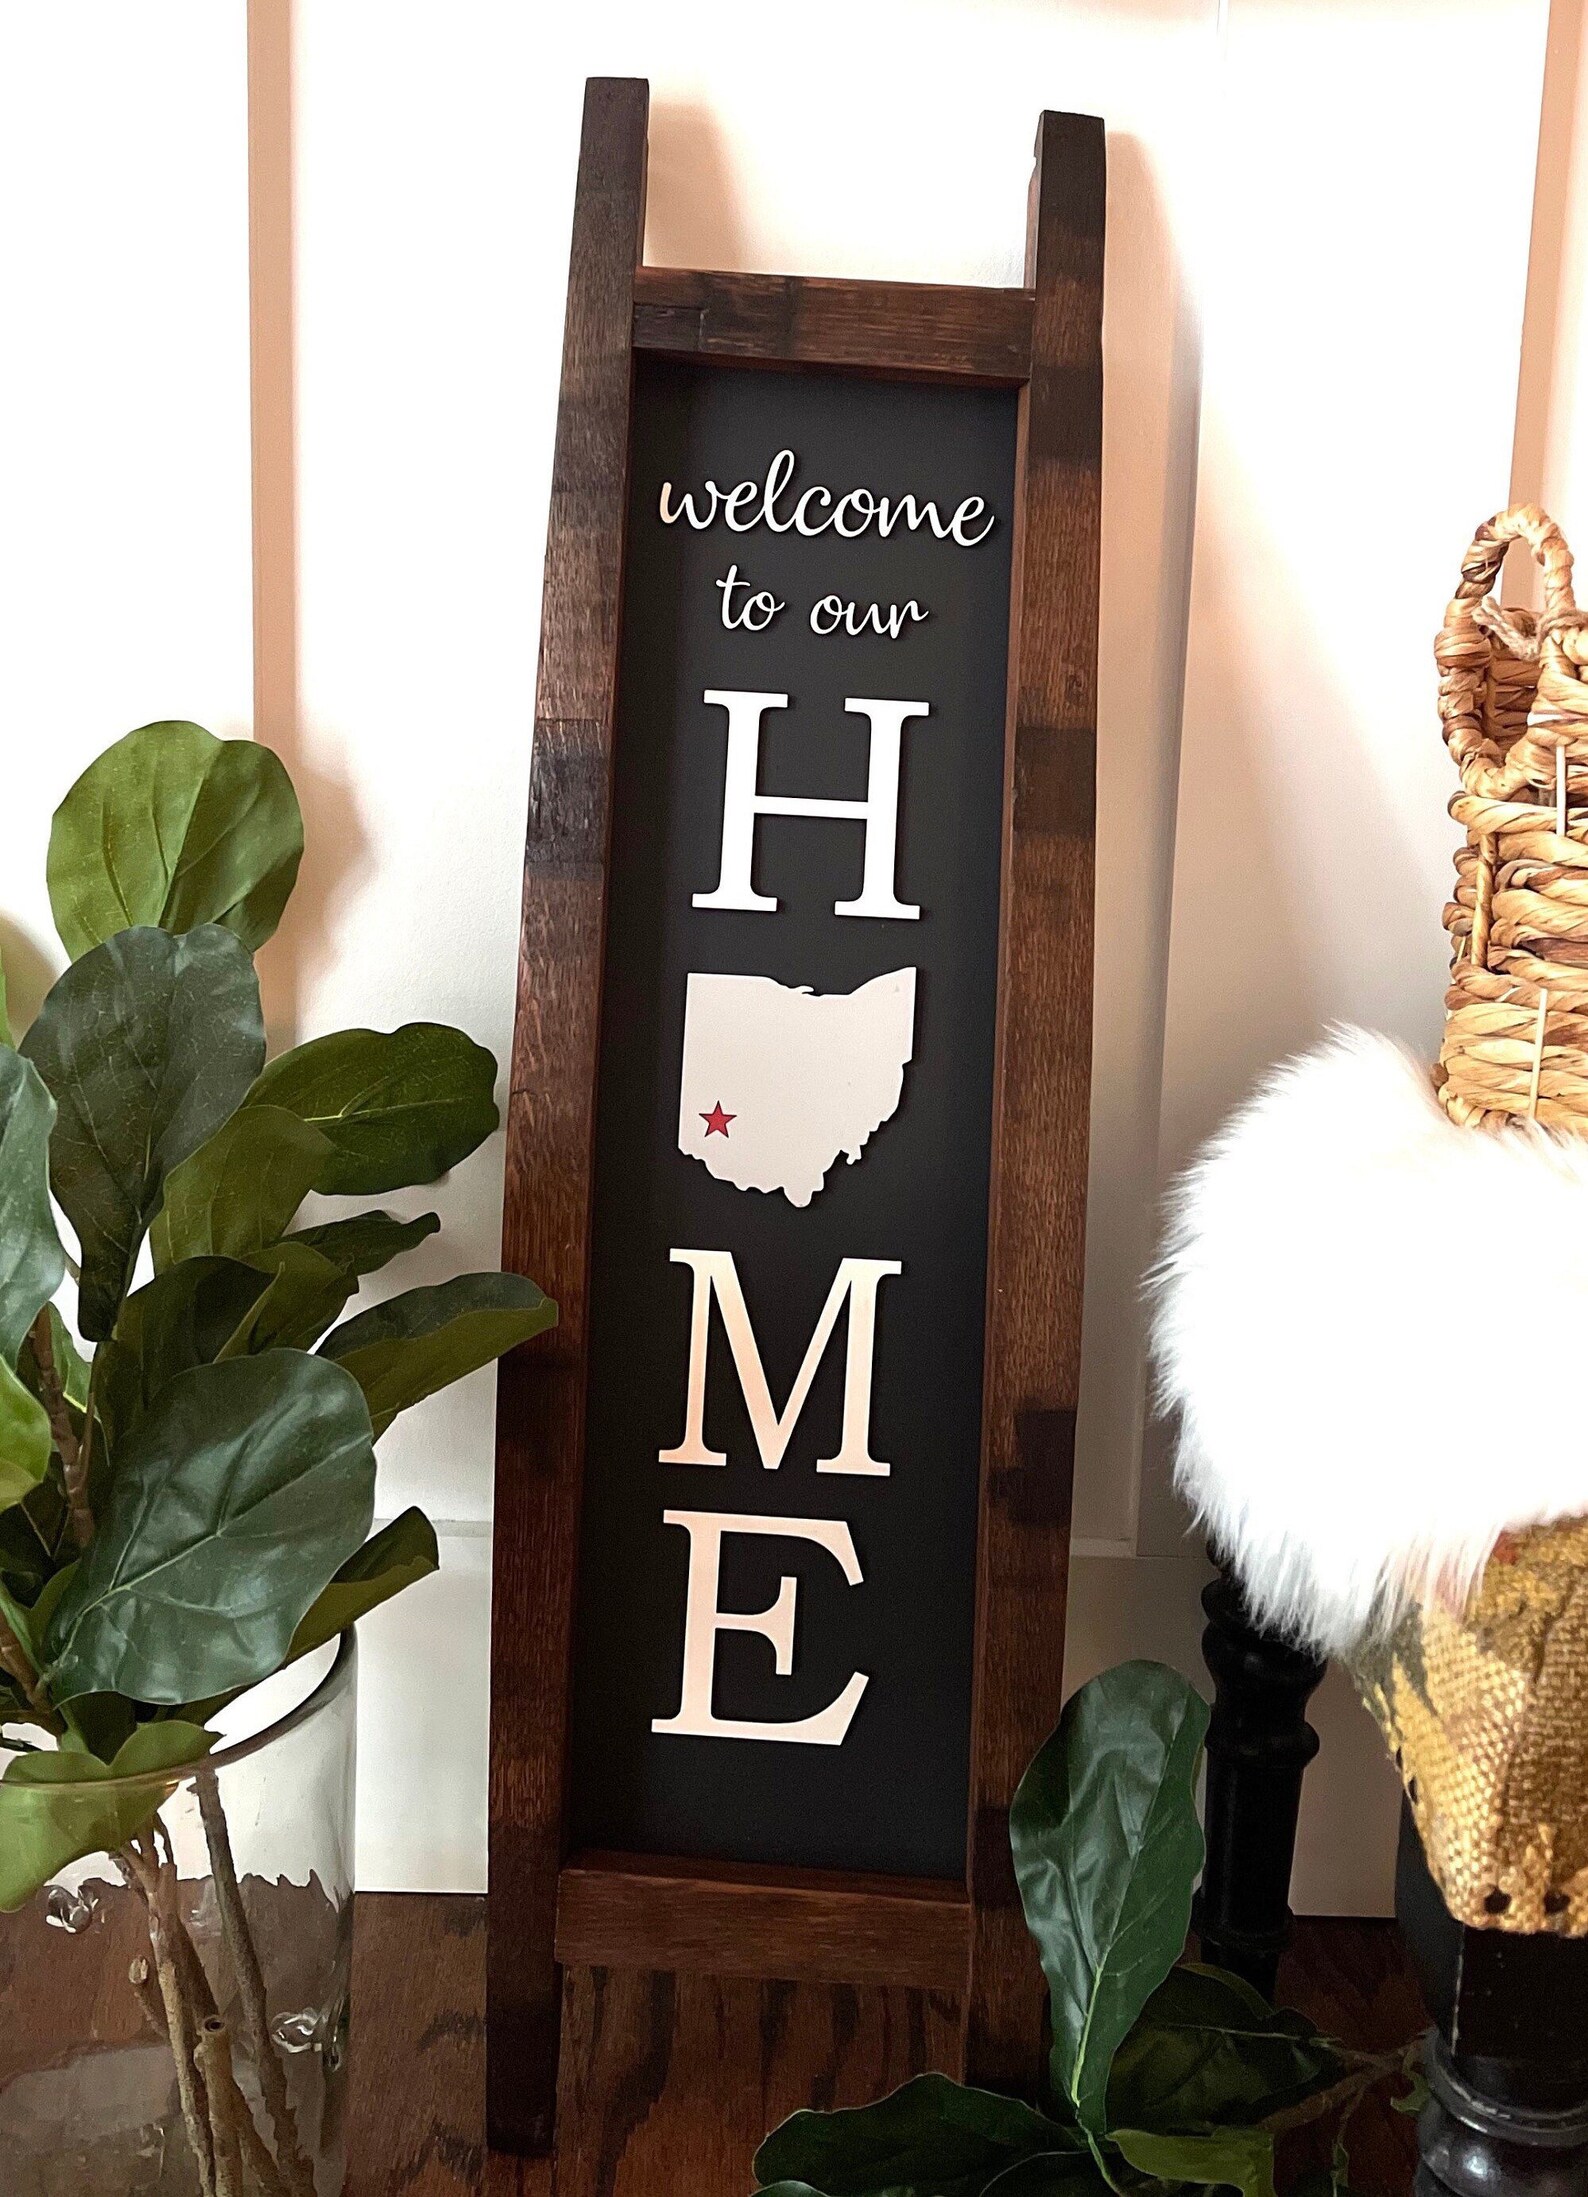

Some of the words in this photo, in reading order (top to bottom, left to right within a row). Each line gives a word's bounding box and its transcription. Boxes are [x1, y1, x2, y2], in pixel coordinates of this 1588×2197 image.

[659, 449, 995, 547] welcome
[715, 564, 786, 631] to
[809, 594, 929, 639] our
[691, 689, 930, 920] H
